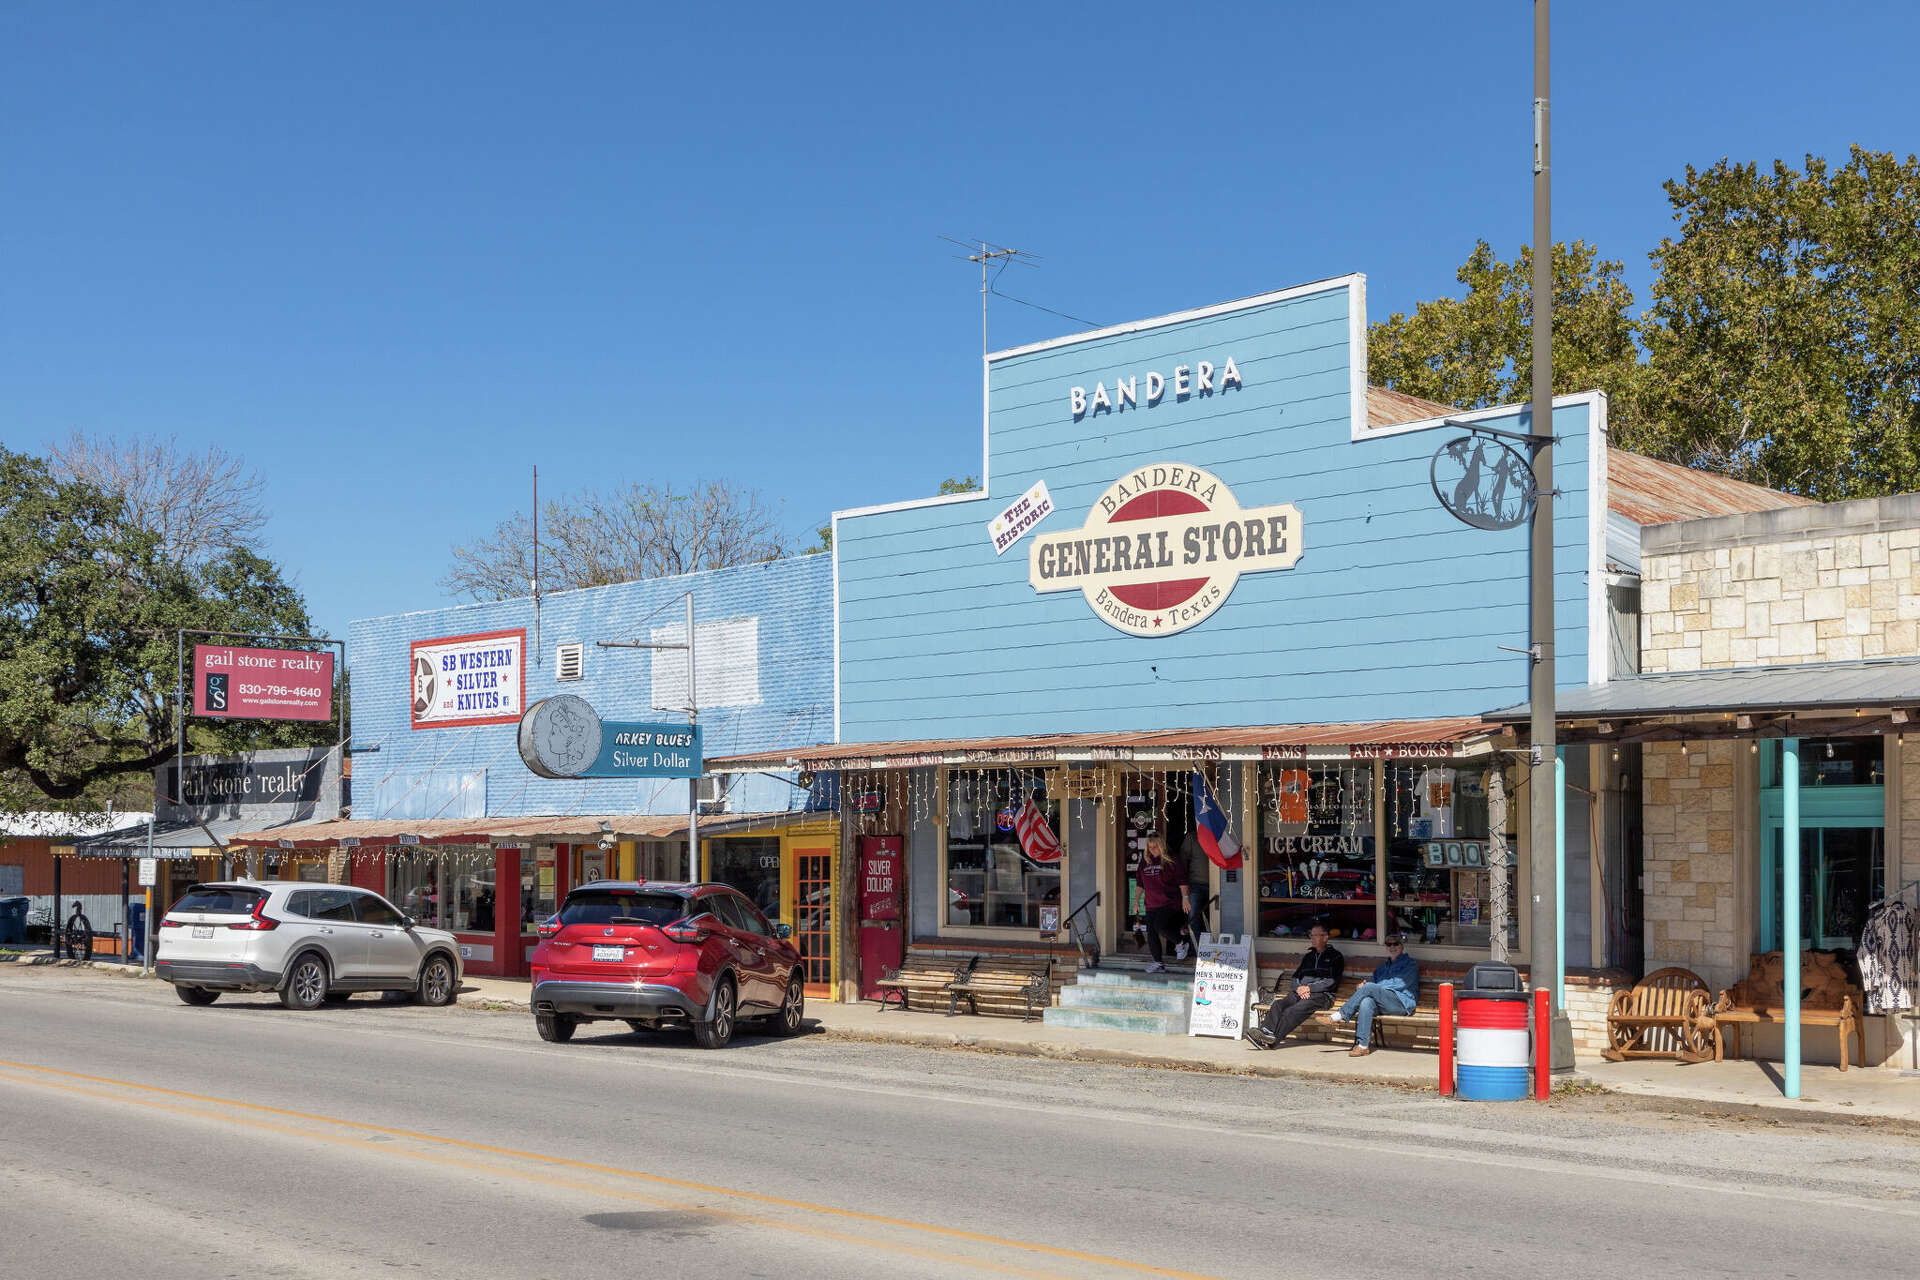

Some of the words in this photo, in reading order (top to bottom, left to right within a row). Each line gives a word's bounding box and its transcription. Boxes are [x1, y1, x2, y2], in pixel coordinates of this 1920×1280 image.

[1070, 356, 1243, 416] BANDERA
[1100, 467, 1218, 517] BANDERA
[1004, 497, 1031, 525] THE
[996, 499, 1051, 550] HISTORIC
[1038, 531, 1174, 580] GENERAL
[1183, 515, 1288, 565] STORE
[1095, 588, 1149, 629] Bandera
[1169, 584, 1221, 626] Texas
[205, 651, 234, 668] gail
[238, 656, 277, 669] stone
[281, 655, 324, 674] realty
[442, 655, 457, 672] SB
[460, 649, 513, 670] WESTERN
[456, 671, 498, 691] SILVER
[239, 683, 321, 698] 830-796-4640
[457, 691, 499, 711] KNIVES
[615, 732, 652, 746] ARKEY
[655, 733, 693, 747] BLUE'S
[613, 750, 648, 768] Silver
[653, 751, 691, 768] Dollar
[967, 750, 995, 762] SODA
[999, 749, 1057, 762] FOUNTAIN
[1091, 749, 1133, 760] MALTS
[1172, 746, 1221, 760] SALSAS
[1266, 745, 1302, 759] JAMS
[1353, 743, 1382, 758] ART
[1399, 743, 1449, 758] BOOKS
[806, 760, 836, 771] TEXAS
[212, 775, 252, 796] stone
[261, 765, 307, 798] realty
[1269, 837, 1297, 854] ICE
[1300, 835, 1364, 854] CREAM
[868, 860, 891, 876] SILVER
[866, 877, 893, 893] DOLLAR
[1215, 972, 1243, 980] WOMEN'S
